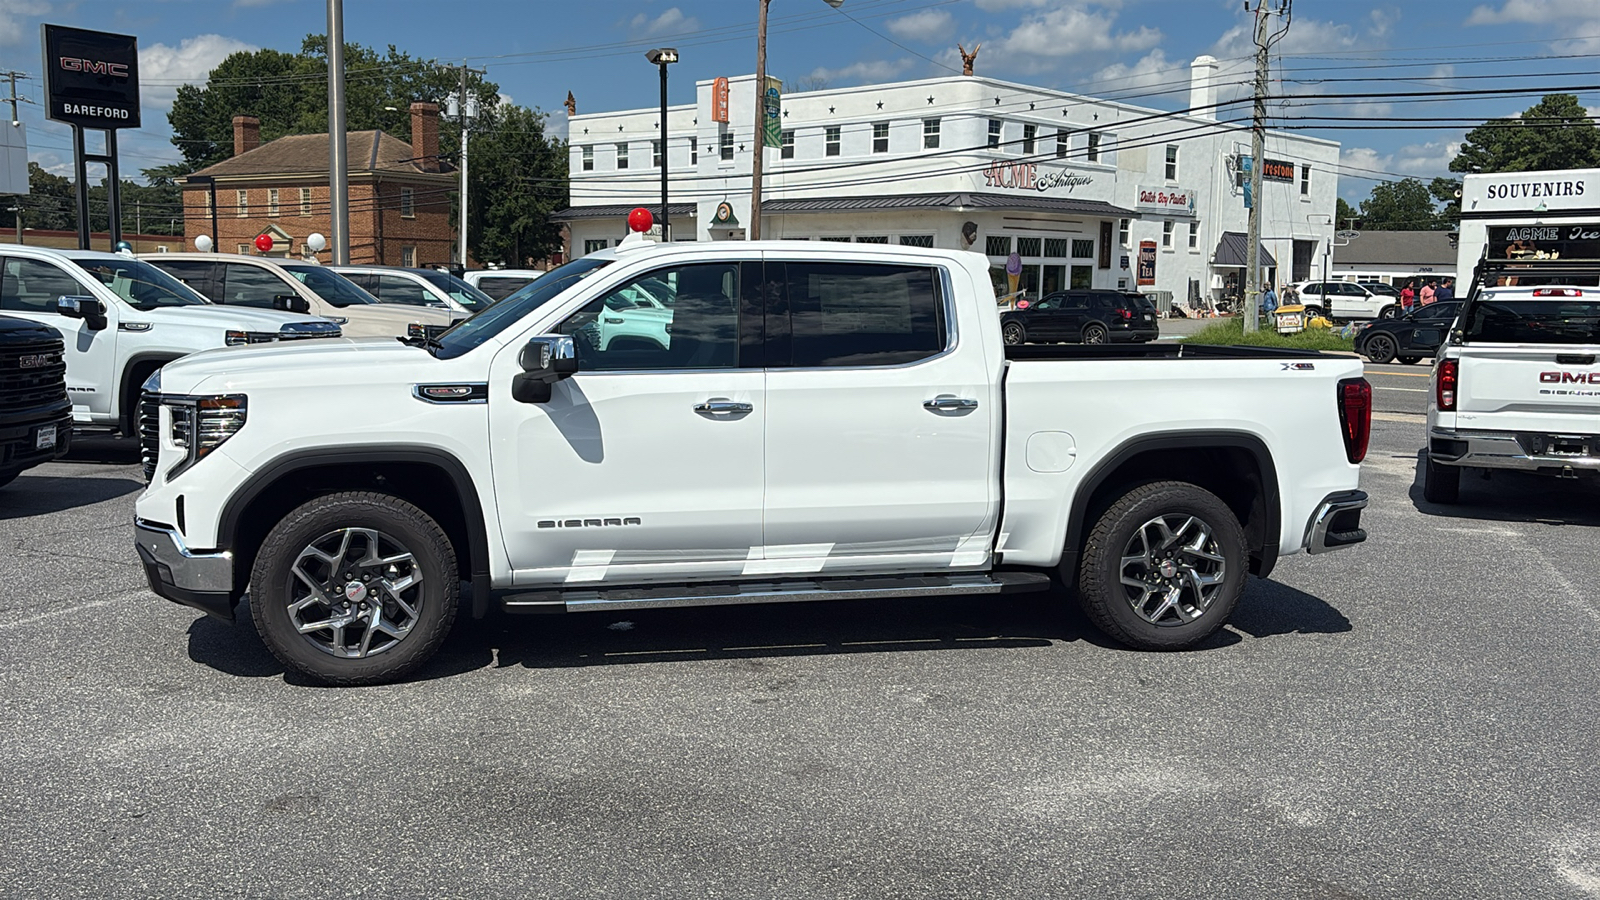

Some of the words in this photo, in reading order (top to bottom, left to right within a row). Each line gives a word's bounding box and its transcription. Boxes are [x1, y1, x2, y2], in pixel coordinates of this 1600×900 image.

[60, 56, 129, 78] GMC
[63, 103, 129, 119] BAREFORD
[983, 159, 1037, 190] ACME
[1487, 181, 1585, 199] SOUVENIRS
[1140, 190, 1156, 203] Dutch
[1157, 192, 1168, 206] Boy
[1169, 193, 1186, 205] Paints
[1506, 227, 1559, 240] ACME
[1569, 227, 1600, 239] Ice
[1142, 265, 1153, 277] TEA
[20, 353, 53, 368] GMC
[1540, 371, 1600, 384] GMC
[537, 517, 641, 529] SIERRA
